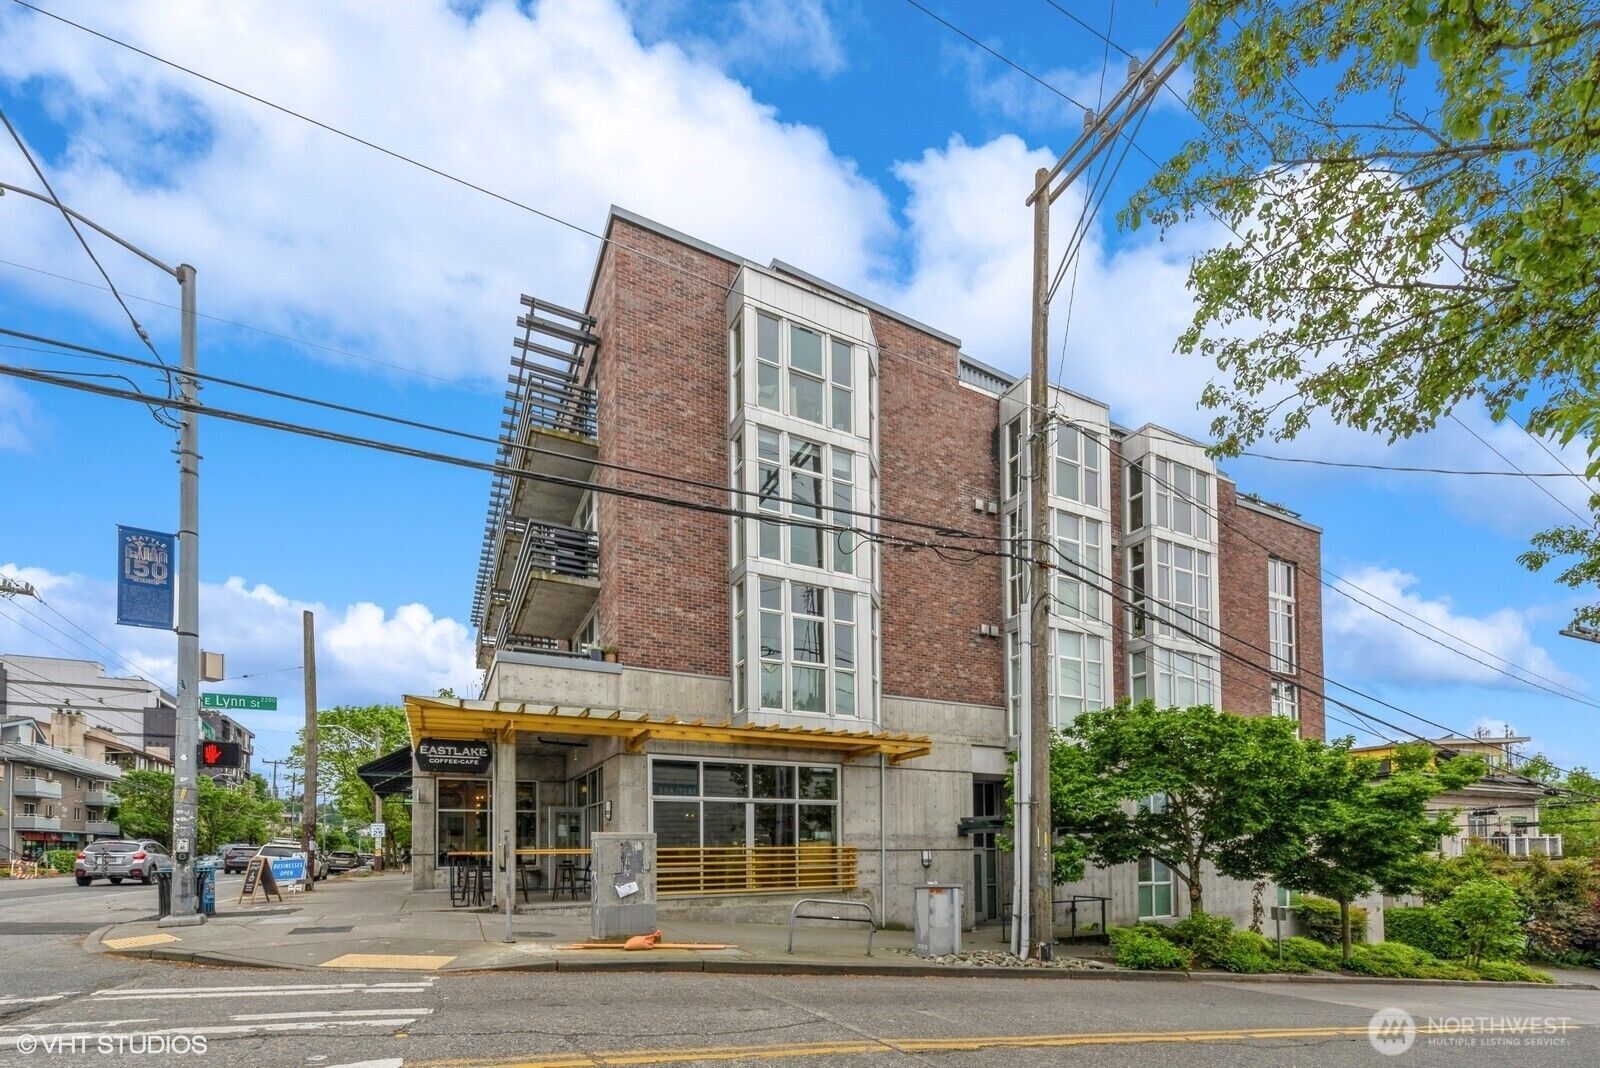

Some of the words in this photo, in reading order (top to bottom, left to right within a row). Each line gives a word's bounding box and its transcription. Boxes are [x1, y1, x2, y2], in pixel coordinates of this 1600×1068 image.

[126, 535, 167, 549] SEATTLE
[125, 558, 168, 580] 150
[204, 697, 211, 705] E
[216, 694, 246, 708] Lynn
[250, 699, 260, 708] St
[420, 745, 488, 757] EASTLAKE
